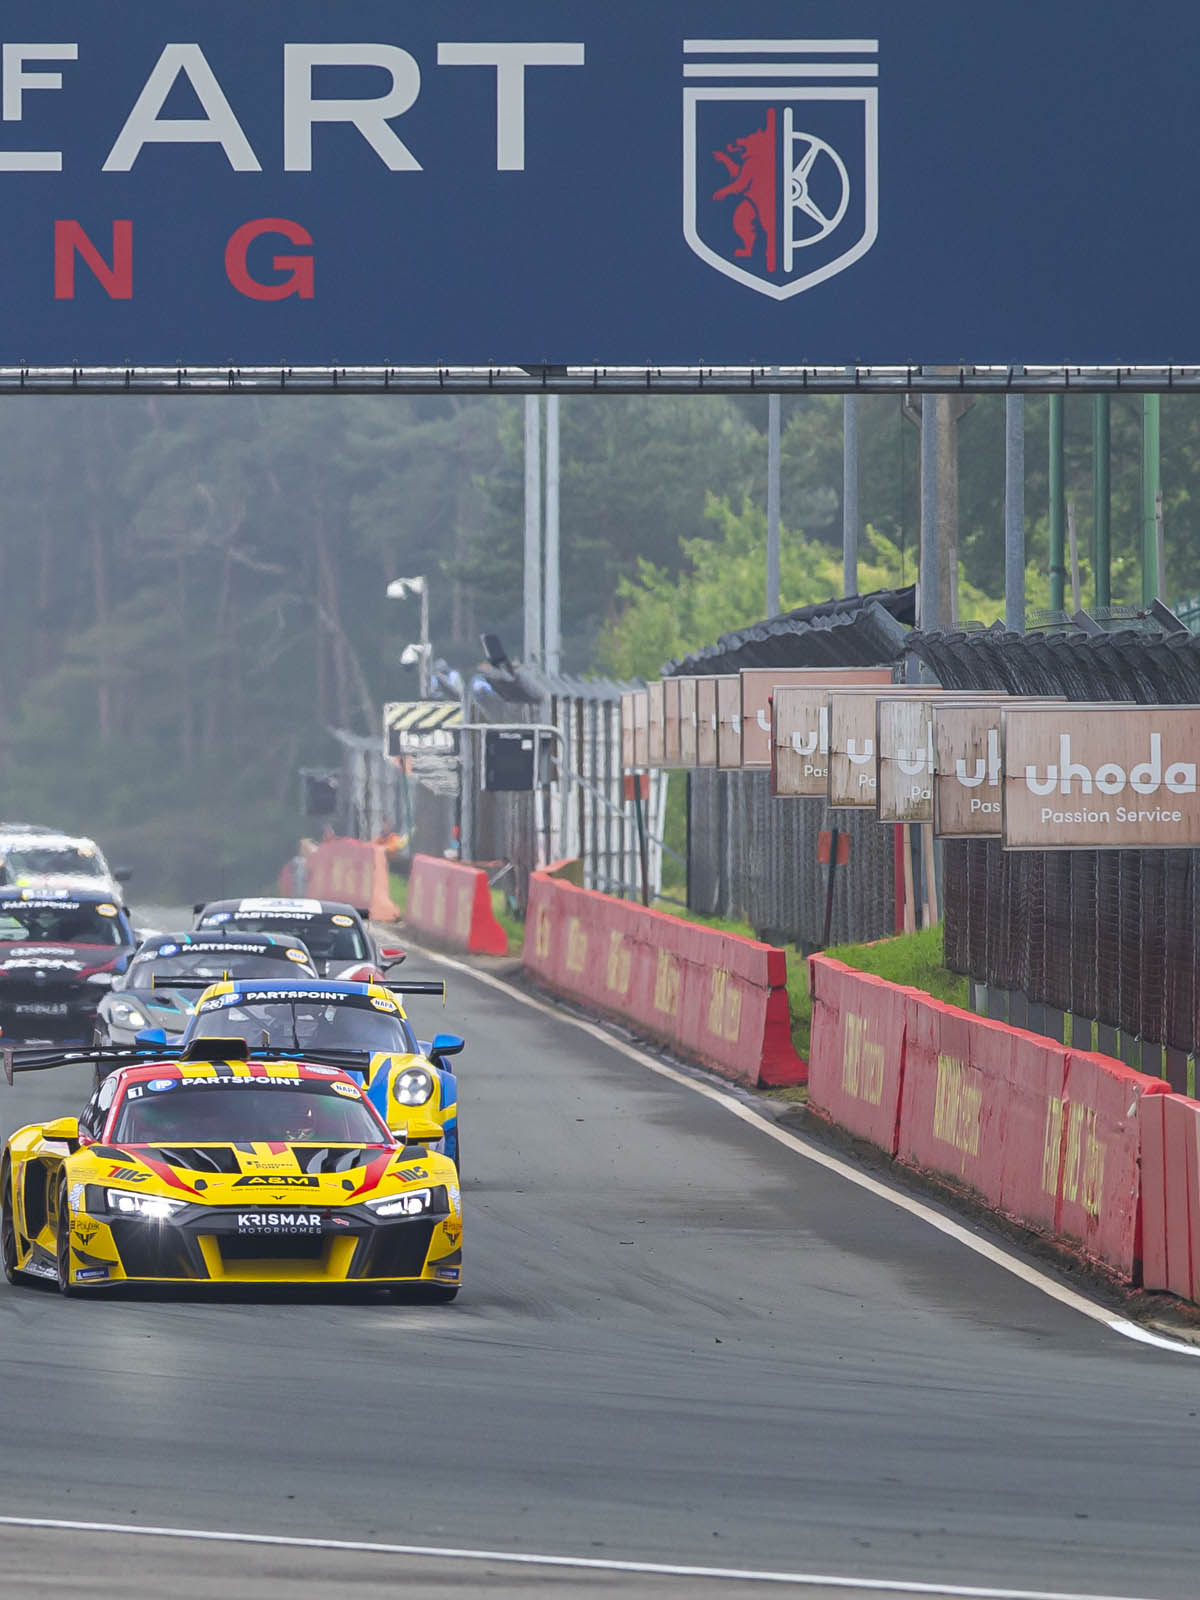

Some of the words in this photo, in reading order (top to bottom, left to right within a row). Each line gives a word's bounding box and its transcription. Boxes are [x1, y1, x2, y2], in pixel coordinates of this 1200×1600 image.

[101, 42, 586, 172] ART
[1024, 733, 1197, 796] uhoda
[1041, 807, 1110, 824] Passion
[1116, 806, 1182, 822] Service
[246, 991, 348, 1001] PARTSPOINT
[182, 1076, 304, 1087] PARTSPOINT
[248, 1176, 309, 1185] A&M
[237, 1213, 322, 1226] KRISMAR
